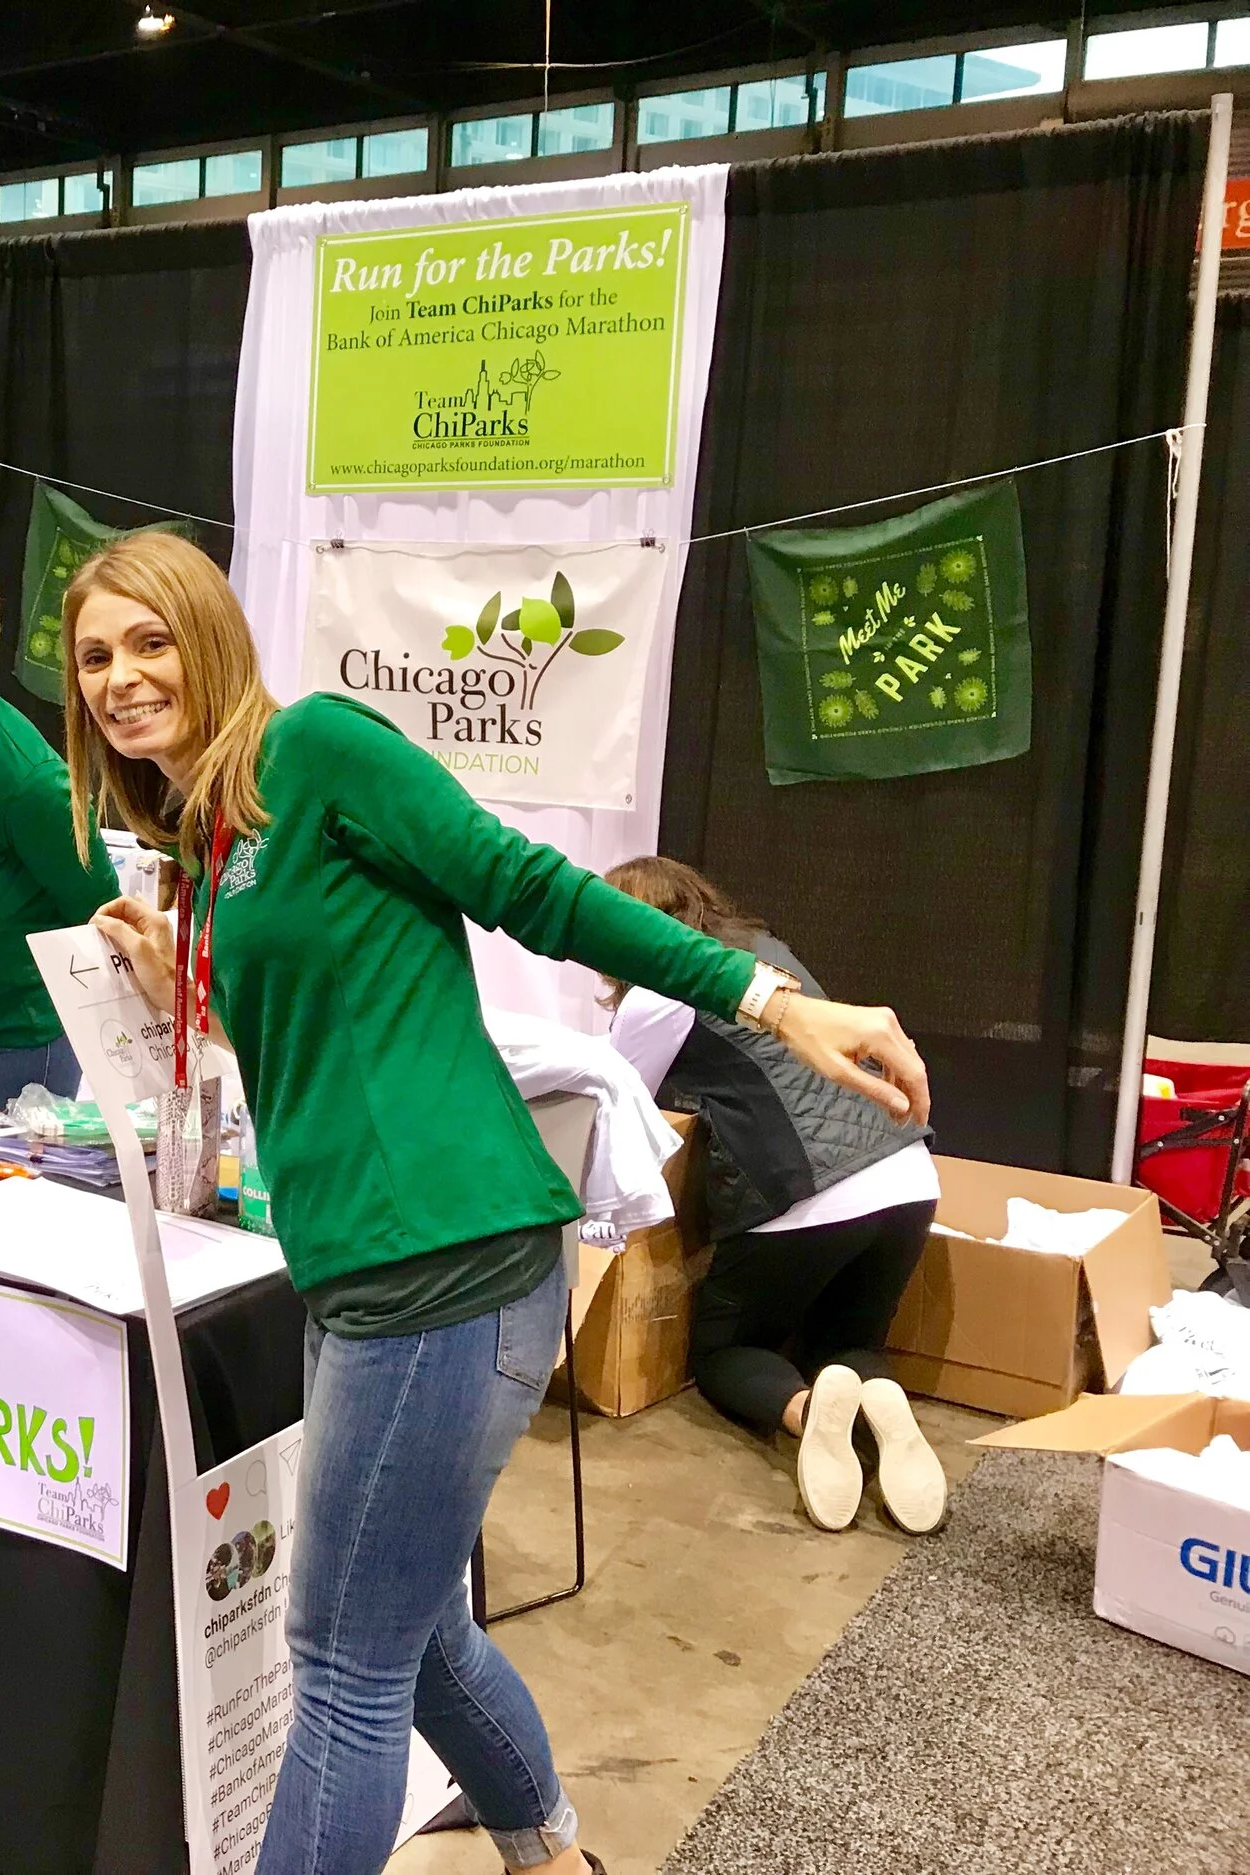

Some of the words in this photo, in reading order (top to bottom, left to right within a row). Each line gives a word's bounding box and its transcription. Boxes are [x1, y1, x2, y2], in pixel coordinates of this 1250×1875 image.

[330, 257, 403, 293] Run
[405, 247, 464, 298] for
[476, 241, 531, 281] the
[542, 228, 673, 276] Parks!
[369, 304, 401, 324] Join
[406, 300, 456, 320] Team
[462, 290, 553, 315] ChiParks
[559, 289, 584, 309] for
[590, 287, 618, 307] the
[327, 330, 370, 351] Bank
[376, 327, 396, 348] of
[398, 323, 475, 347] America
[481, 320, 560, 345] Chicago
[565, 312, 665, 336] Marathon
[414, 391, 465, 410] Team
[412, 441, 447, 450] CHICAGO
[450, 440, 476, 449] PARKS
[478, 438, 530, 448] FOUNDATION
[413, 410, 529, 438] ChiParks
[330, 455, 645, 478] www.chicagoparksfoundation.org/marathon
[839, 608, 881, 665] Meet
[875, 581, 906, 623] Me
[875, 611, 962, 702] PARK
[339, 648, 515, 711] Chicago
[426, 701, 542, 746] Parks
[431, 750, 540, 775] NDATION
[110, 952, 134, 974] Ph
[140, 1016, 175, 1040] chipark
[38, 1481, 68, 1503] Team
[38, 1497, 104, 1535] ChiParks
[281, 1518, 295, 1540] Lik
[204, 1583, 272, 1639] chiparksfdn
[205, 1603, 281, 1670] @chiparksfdn
[206, 1658, 291, 1727] #RunForThePar
[208, 1683, 292, 1754] #ChicagoMarat
[209, 1708, 293, 1781] #ChicagoMarat
[210, 1741, 287, 1808] #BankofAmer
[212, 1772, 276, 1835] #TeamChiP
